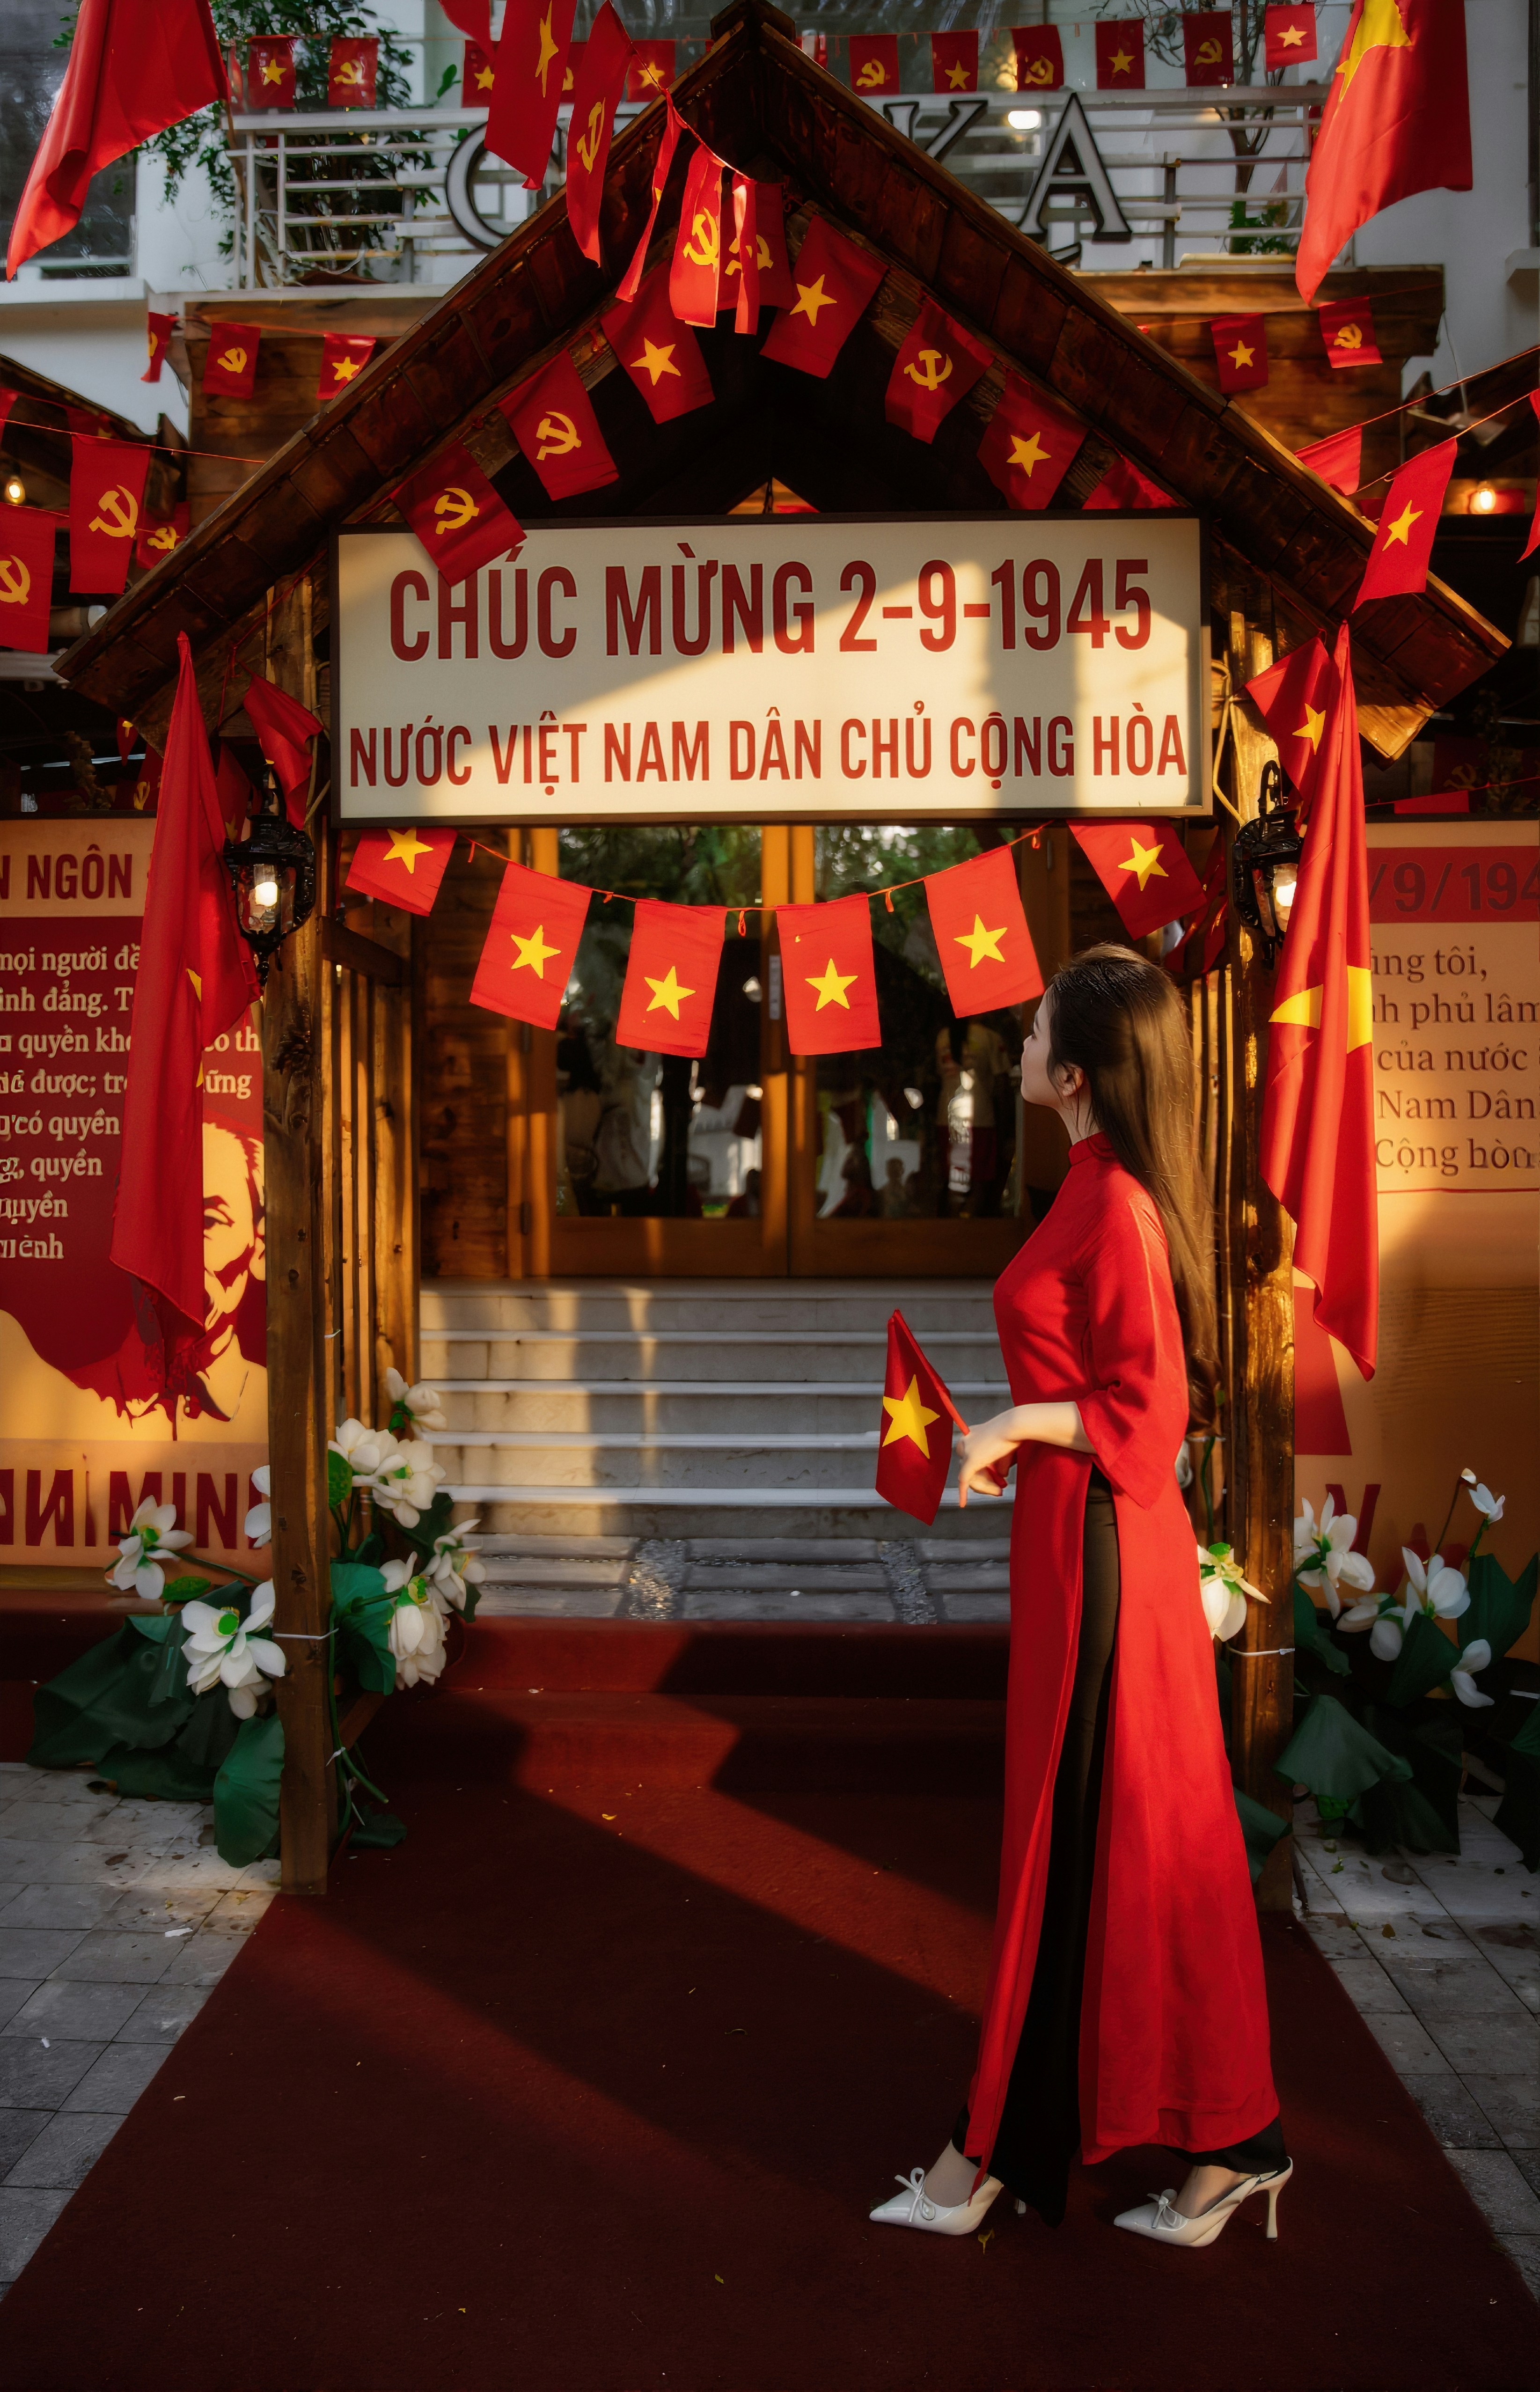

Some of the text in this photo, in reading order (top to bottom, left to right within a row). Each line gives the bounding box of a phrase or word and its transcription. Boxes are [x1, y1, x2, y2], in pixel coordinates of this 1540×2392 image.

[390, 543, 1151, 661] CHÚC MỪNG 2-9-1945
[350, 701, 1187, 796] NƯỚC VIỆT NAM DÂN CHỦ CỘNG HÒA
[27, 844, 132, 899] NGÔN
[41, 945, 108, 977] người
[114, 943, 140, 971] đề
[1434, 946, 1487, 982] tôi,
[43, 980, 109, 1018] đẳng.
[1410, 991, 1476, 1030] phủ
[236, 1026, 261, 1052] th
[1378, 1040, 1528, 1071] của nước
[31, 1069, 96, 1098] được;
[1378, 1089, 1536, 1119] Nam Dân
[1376, 1137, 1459, 1177] Cộng
